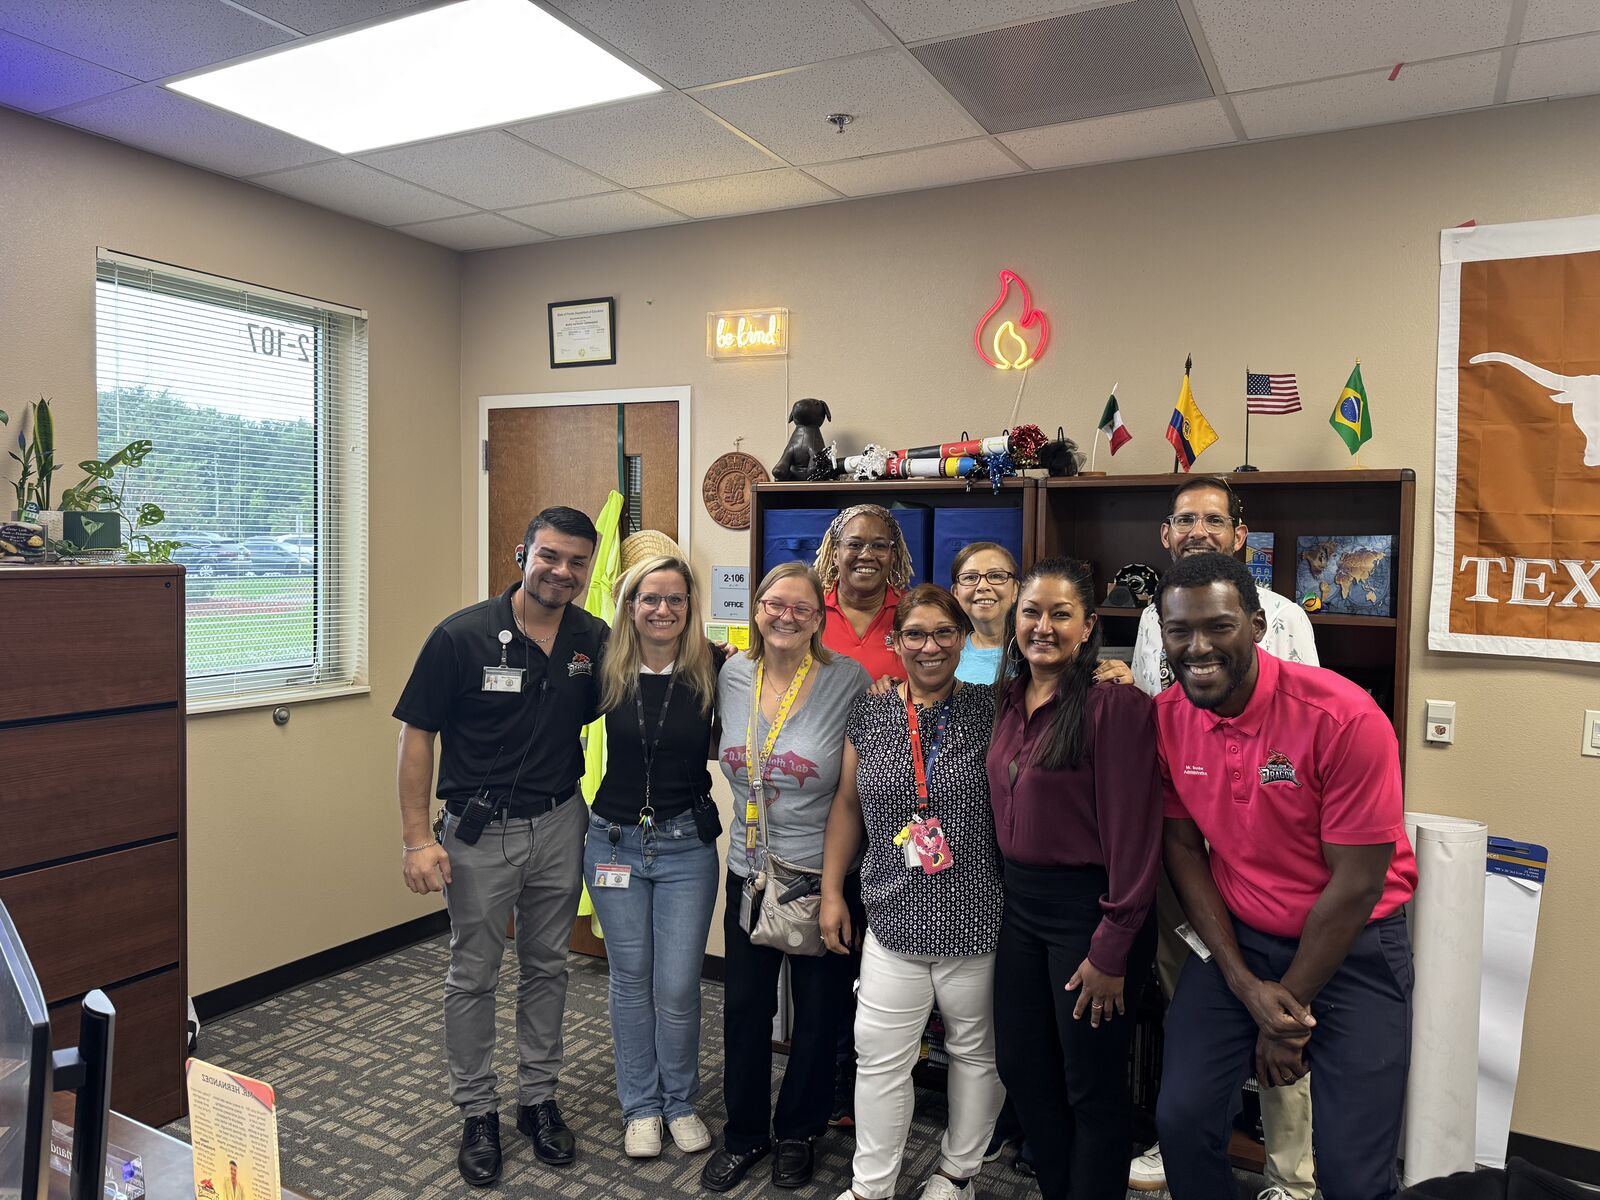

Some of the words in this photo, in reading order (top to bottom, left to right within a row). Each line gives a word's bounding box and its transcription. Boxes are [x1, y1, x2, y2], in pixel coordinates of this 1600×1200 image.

[716, 318, 737, 348] be
[737, 314, 776, 348] kind
[723, 573, 745, 583] 2-106
[723, 600, 744, 608] OFFICE
[768, 757, 786, 767] ath
